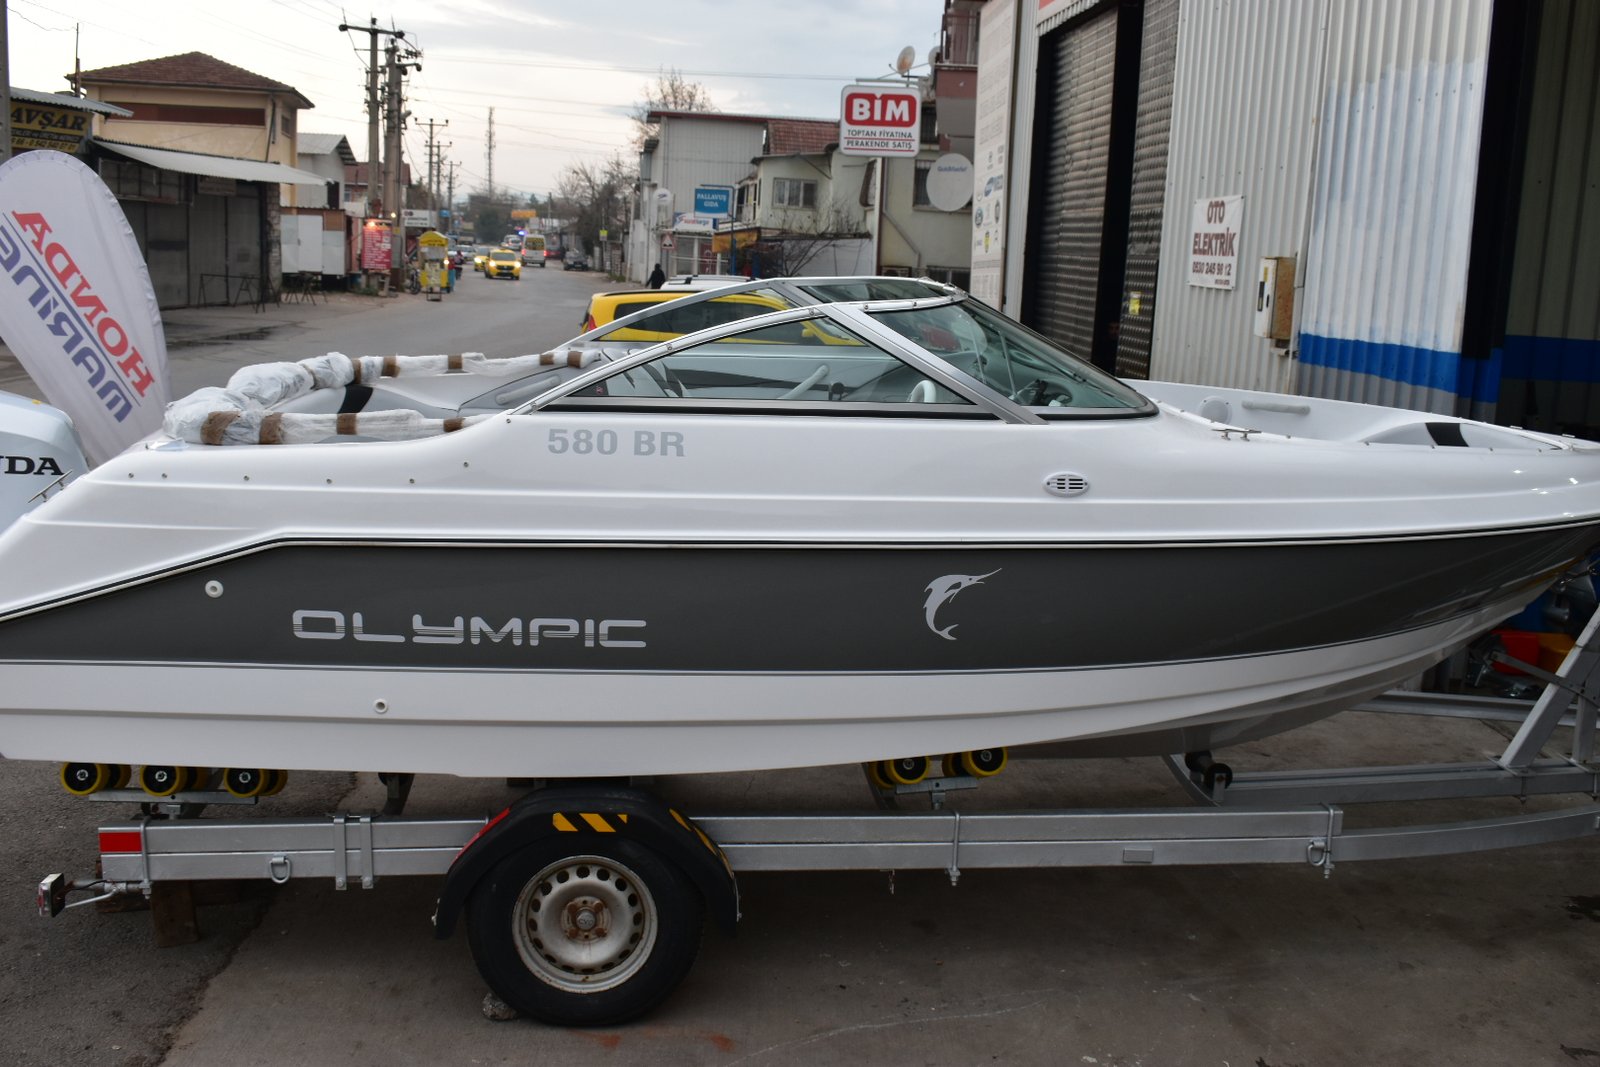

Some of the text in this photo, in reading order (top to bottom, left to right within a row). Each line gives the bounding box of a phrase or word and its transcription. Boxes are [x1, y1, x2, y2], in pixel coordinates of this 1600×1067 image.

[846, 140, 912, 149] PERAKENDE SATIŞ
[847, 129, 913, 138] TOPTAN FİYATINA
[1207, 200, 1226, 224] OTO
[1192, 226, 1237, 257] ELEKTRİK
[547, 428, 686, 457] 580 BR
[0, 455, 65, 476] DA
[292, 609, 647, 648] OLYMPIC
